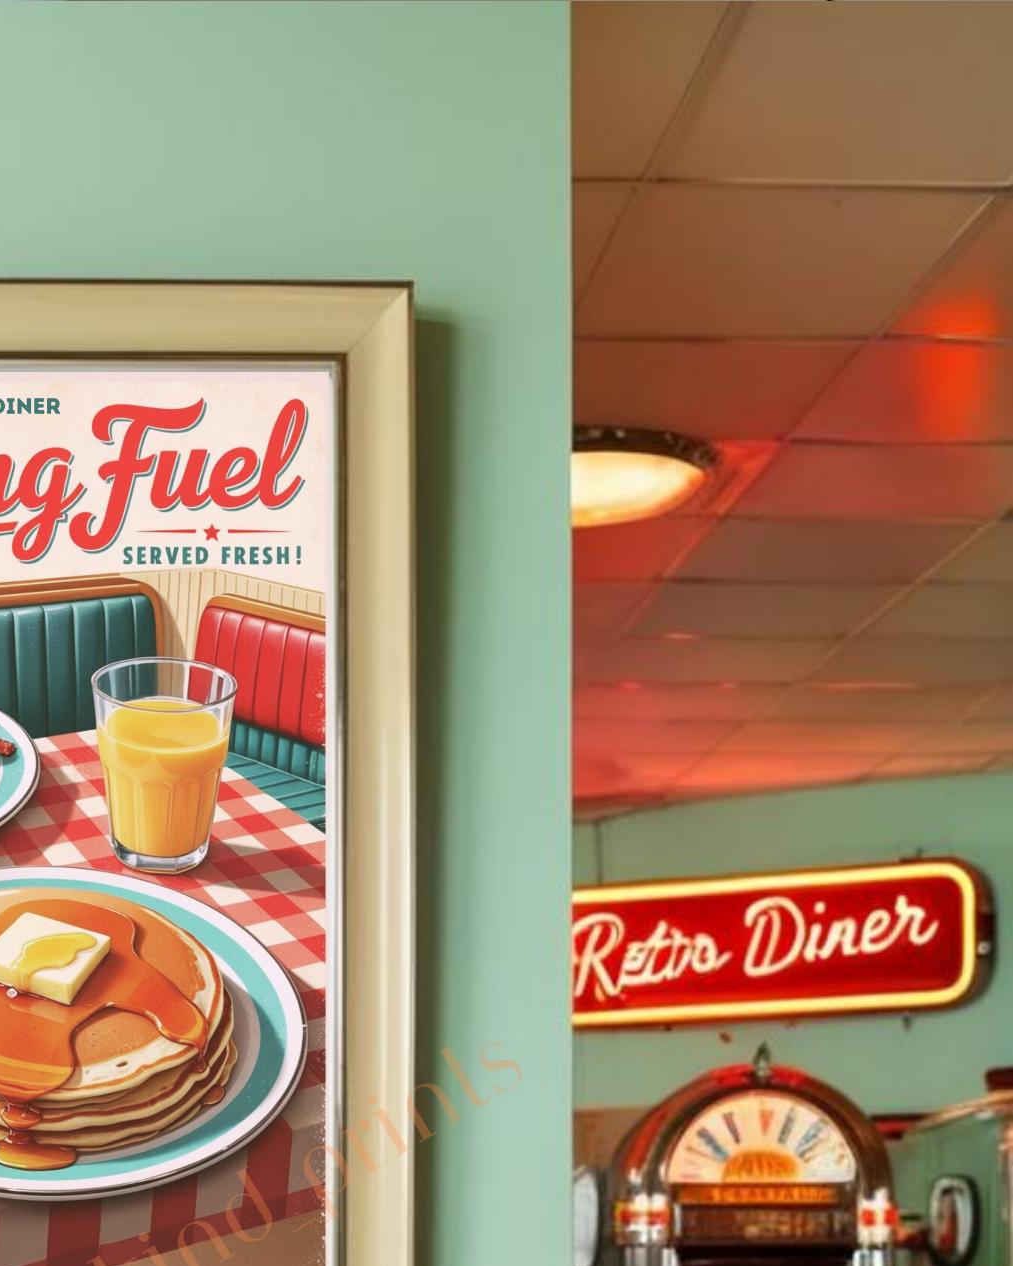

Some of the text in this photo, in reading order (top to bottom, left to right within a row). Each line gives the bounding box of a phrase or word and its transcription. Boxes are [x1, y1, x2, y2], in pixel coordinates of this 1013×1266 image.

[69, 398, 308, 552] Fuel
[123, 545, 302, 565] SERVED FRESH!
[744, 895, 938, 977] Diner
